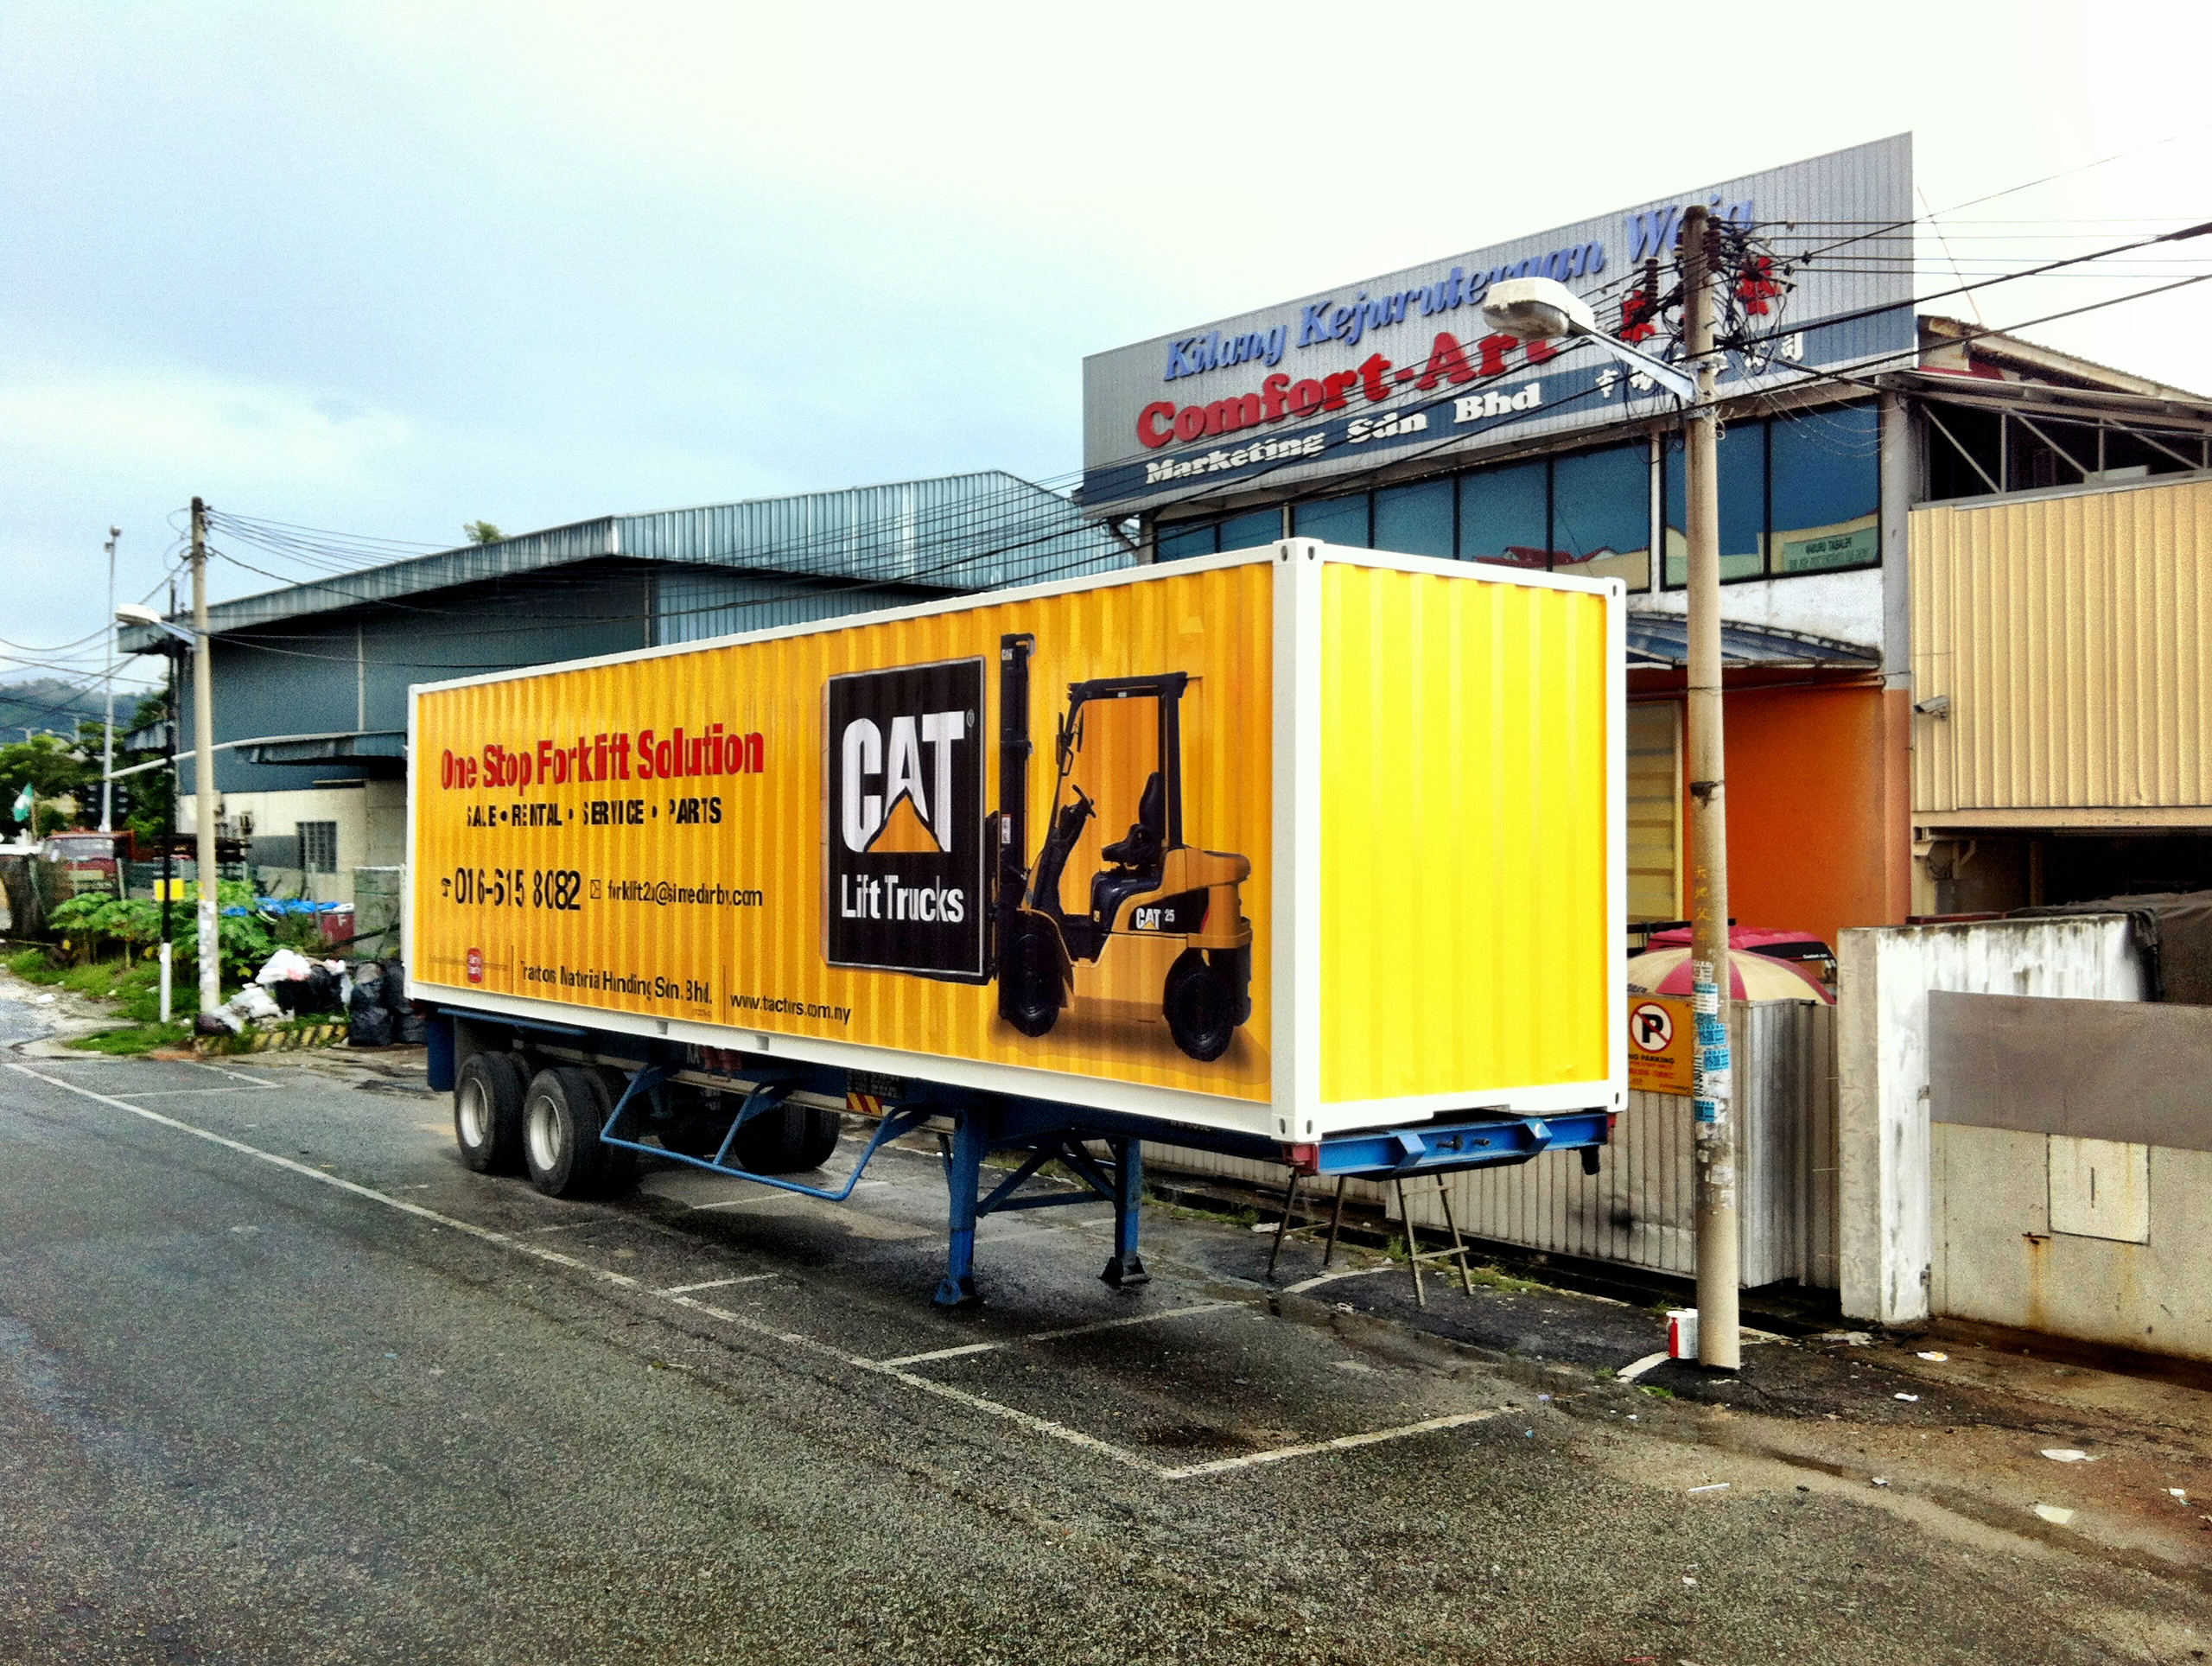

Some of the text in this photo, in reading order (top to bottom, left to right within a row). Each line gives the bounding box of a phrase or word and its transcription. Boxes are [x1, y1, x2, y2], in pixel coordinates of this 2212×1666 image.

[1164, 325, 1287, 381] Kilang
[1145, 383, 1541, 484] Marketing Sdn Bhd
[442, 722, 764, 797] One Stop Forklift Solution
[842, 710, 964, 854] CAT
[467, 797, 722, 827] SALE RENTAL SERVICE PARTS
[842, 874, 963, 923] Lift Trucks
[1135, 907, 1161, 931] CAT
